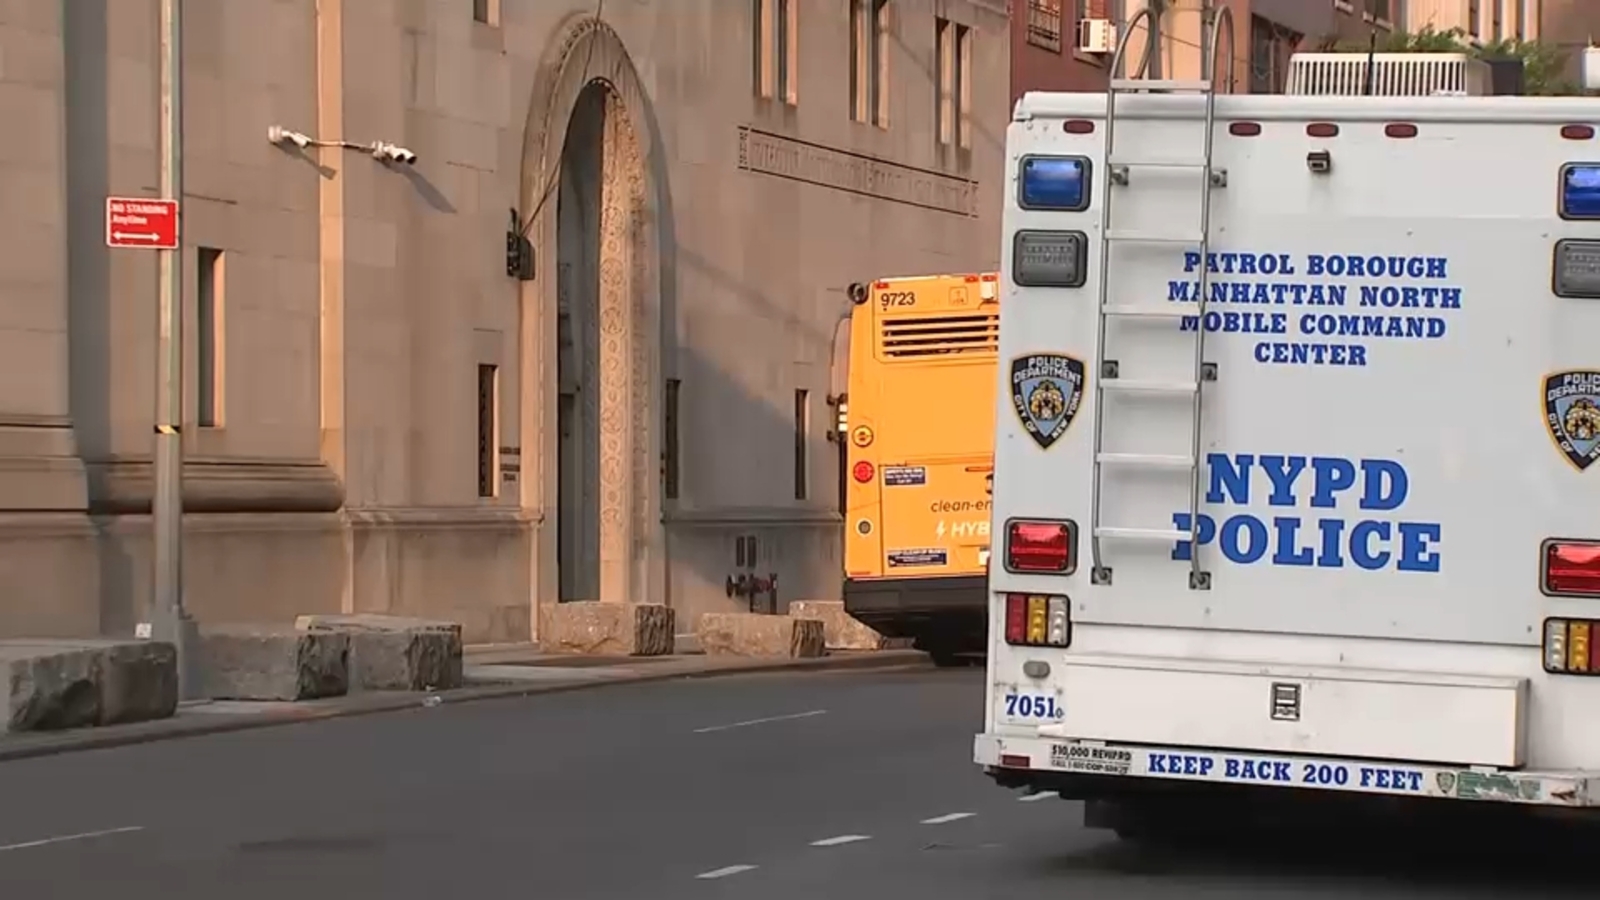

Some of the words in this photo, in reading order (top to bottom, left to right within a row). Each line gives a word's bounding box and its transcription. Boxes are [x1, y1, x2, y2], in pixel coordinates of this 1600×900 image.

[1184, 252, 1294, 275] PATROL
[1307, 254, 1447, 279] BOROUGH
[881, 292, 916, 306] 9723
[1360, 285, 1461, 309] NORTH
[1180, 311, 1287, 334] MOBILE
[1300, 314, 1446, 338] COMMAND
[1028, 356, 1069, 369] POLICE
[1254, 342, 1367, 366] CENTER
[1013, 366, 1081, 385] DEPARTMENT
[1205, 453, 1409, 510] NYPD
[1172, 512, 1441, 572] POLICE
[1052, 744, 1090, 759] $10,000
[1149, 753, 1214, 776] KEEP
[1224, 758, 1291, 781] BACK
[1302, 764, 1348, 785] 200
[1360, 767, 1423, 791] FEET
